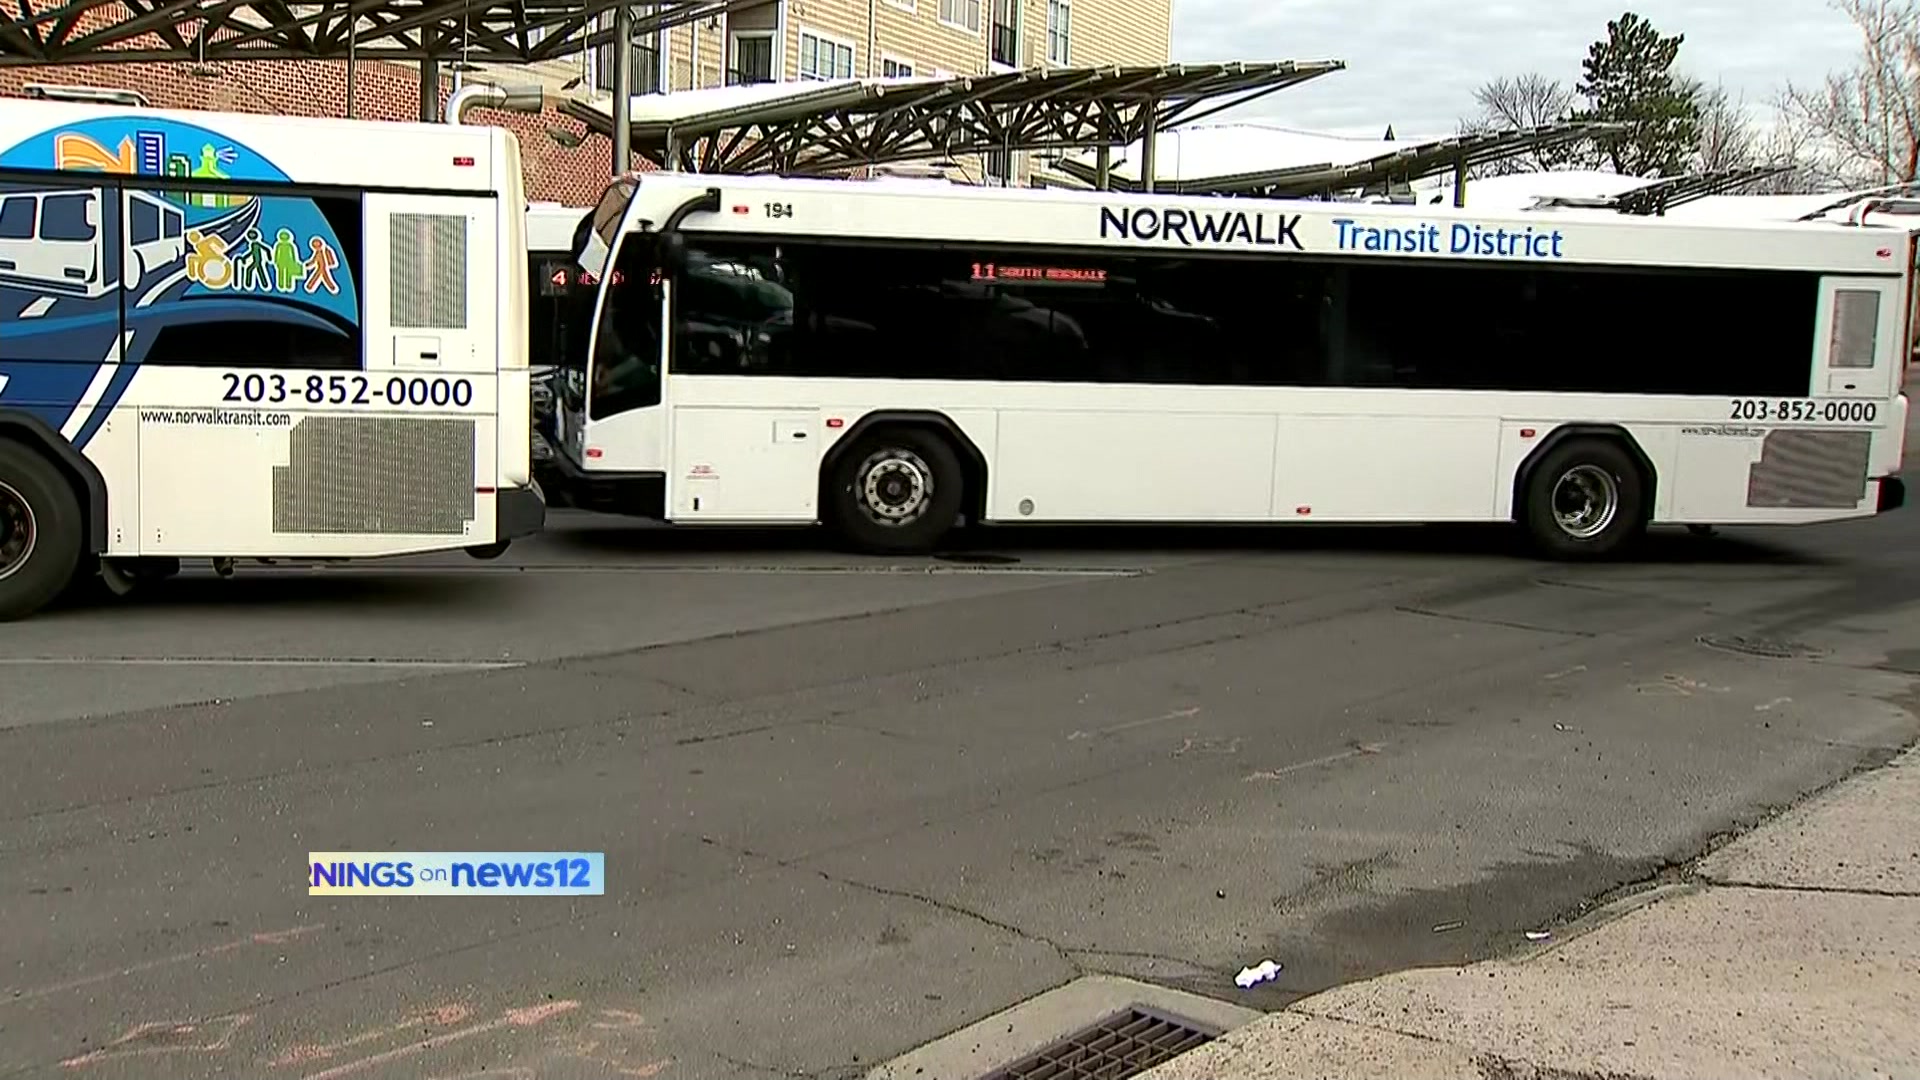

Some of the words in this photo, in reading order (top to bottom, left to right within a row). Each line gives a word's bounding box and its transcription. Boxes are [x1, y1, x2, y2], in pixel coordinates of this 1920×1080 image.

[763, 202, 793, 219] 194
[1099, 207, 1304, 251] NORWALK
[1332, 219, 1440, 253] Transit
[1450, 223, 1564, 257] District
[551, 269, 567, 286] 4
[971, 262, 997, 280] 11
[222, 373, 473, 406] 203-852-0000
[140, 408, 291, 427] www.norwalktransit.com
[1730, 399, 1877, 422] 203-852-0000
